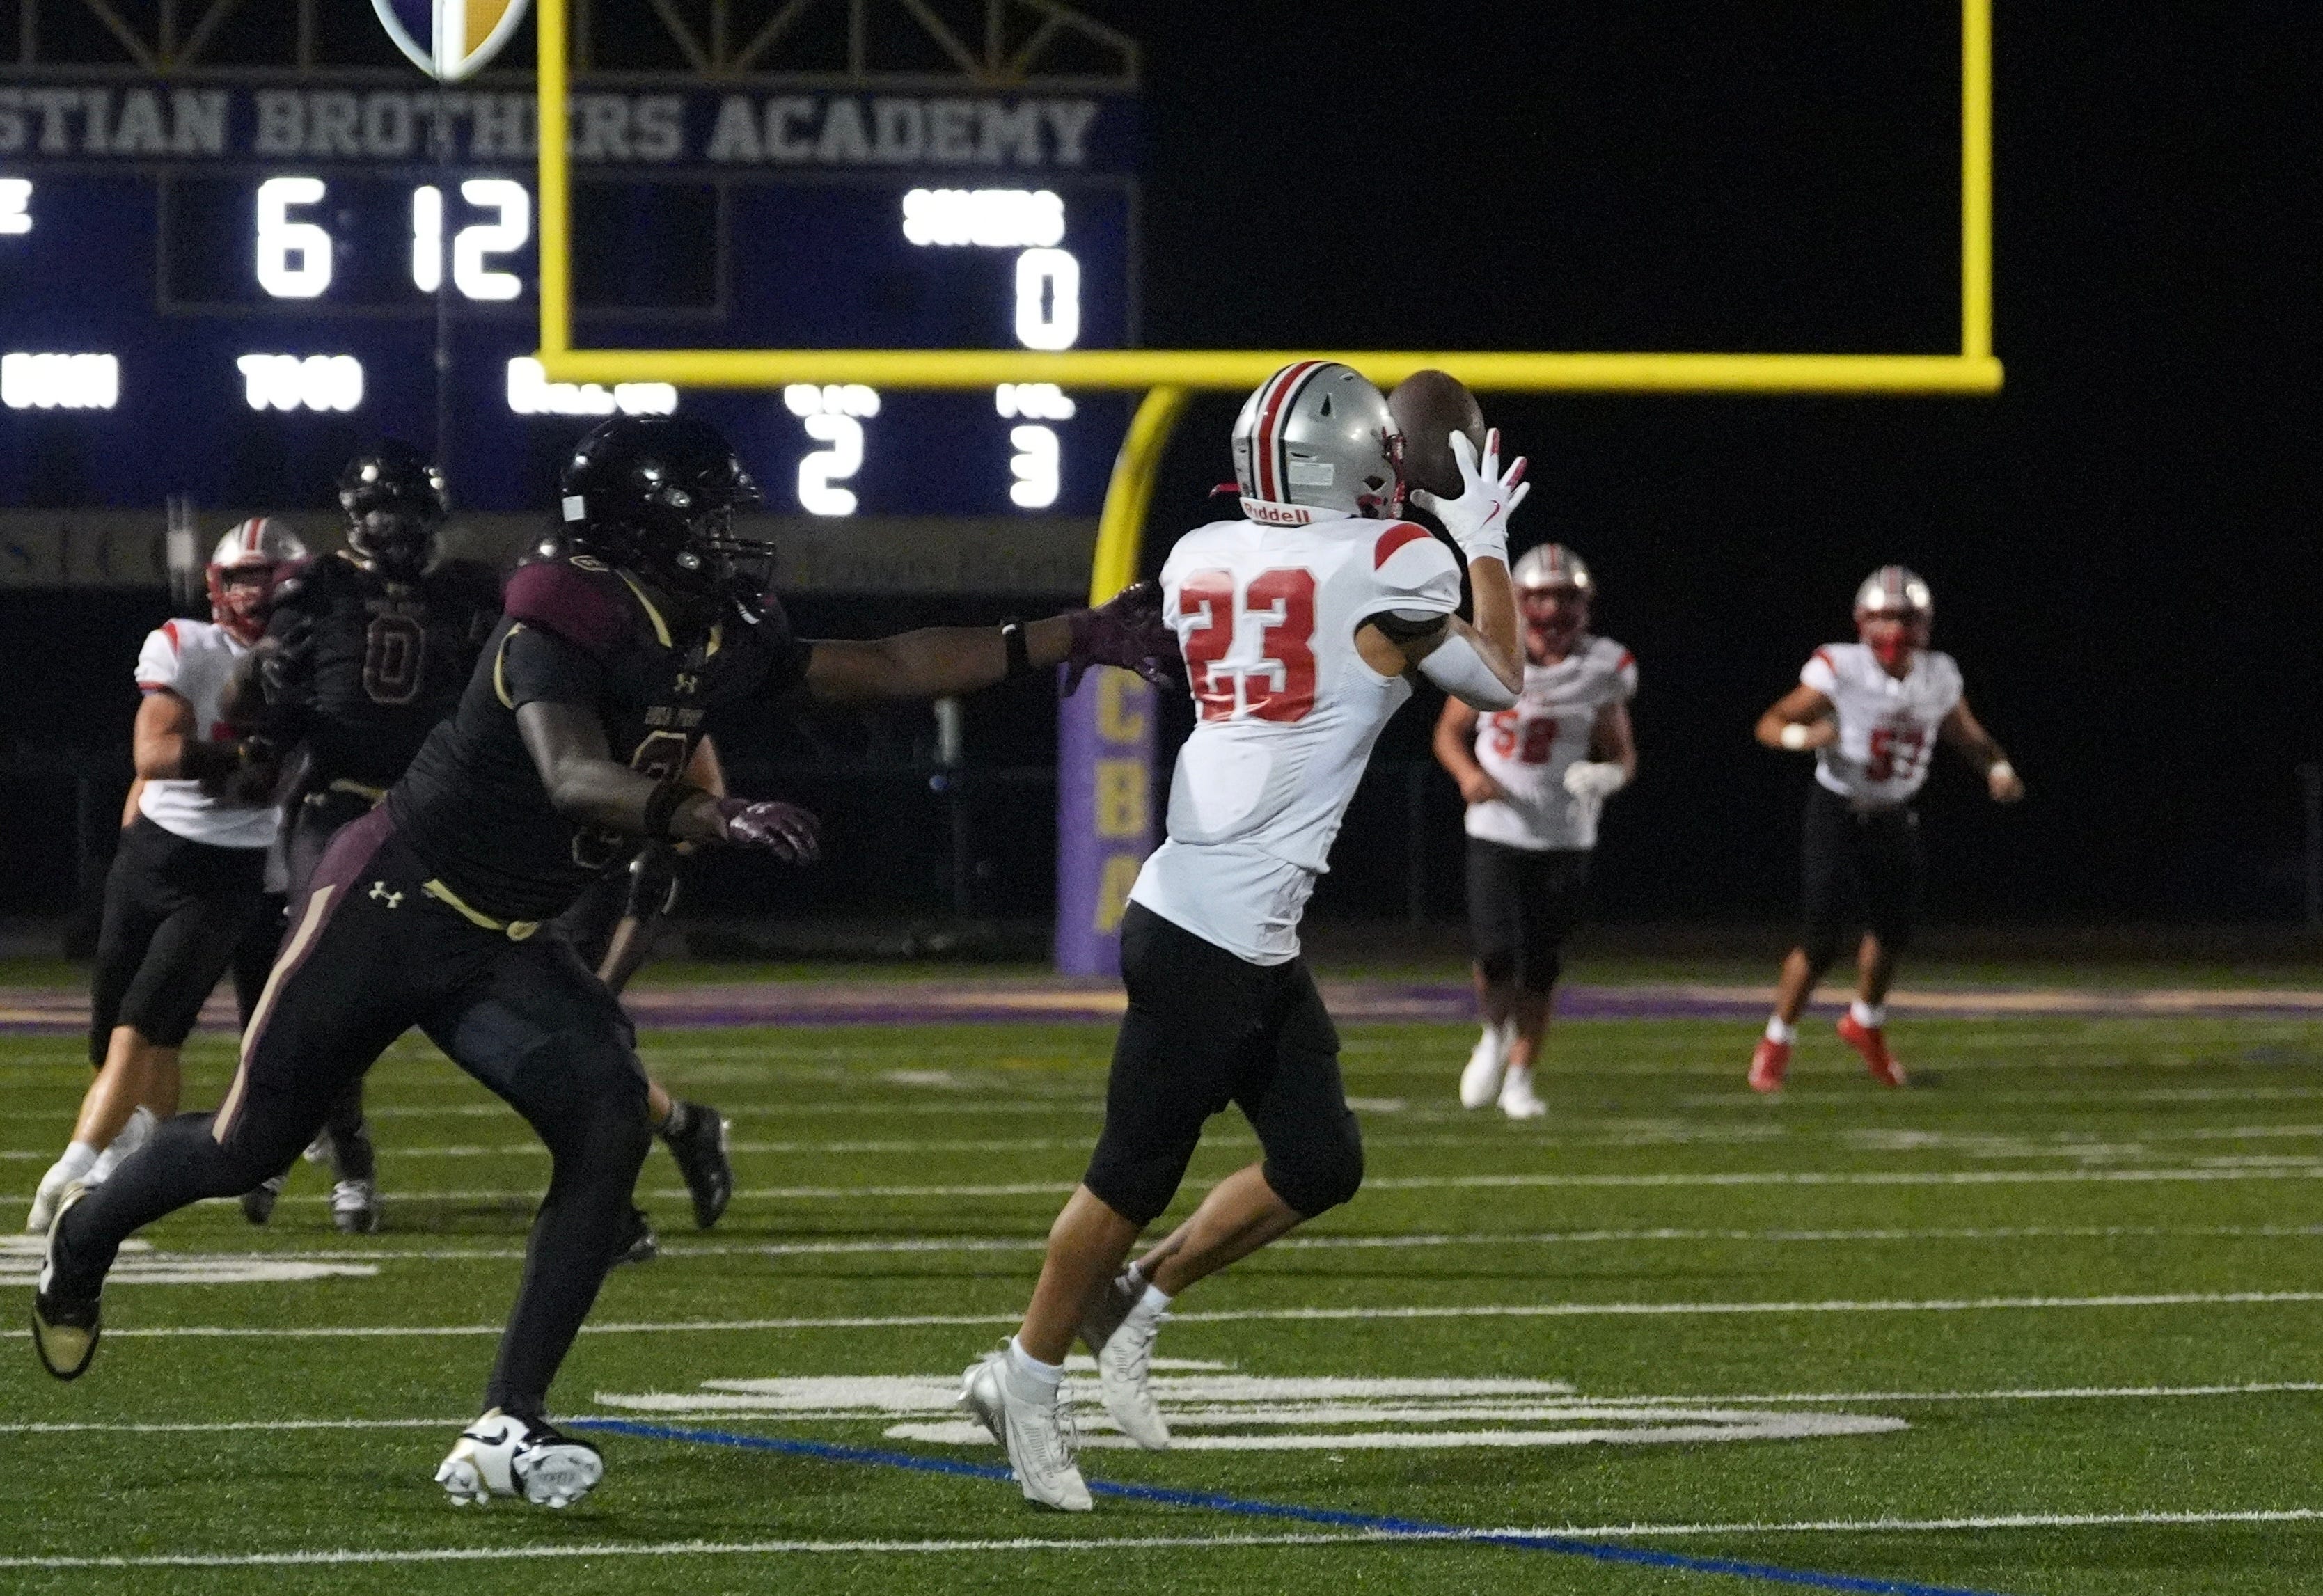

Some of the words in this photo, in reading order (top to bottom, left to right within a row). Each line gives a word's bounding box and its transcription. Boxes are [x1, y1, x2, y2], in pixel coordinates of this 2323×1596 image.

[255, 90, 686, 162] BROTHRS
[707, 96, 1098, 165] ACADEMY
[1016, 248, 1080, 351] 0
[798, 413, 864, 516] 2
[1009, 425, 1060, 509] 3
[1243, 502, 1312, 523] Riddell
[363, 614, 426, 705] 0
[1179, 566, 1321, 724] 23
